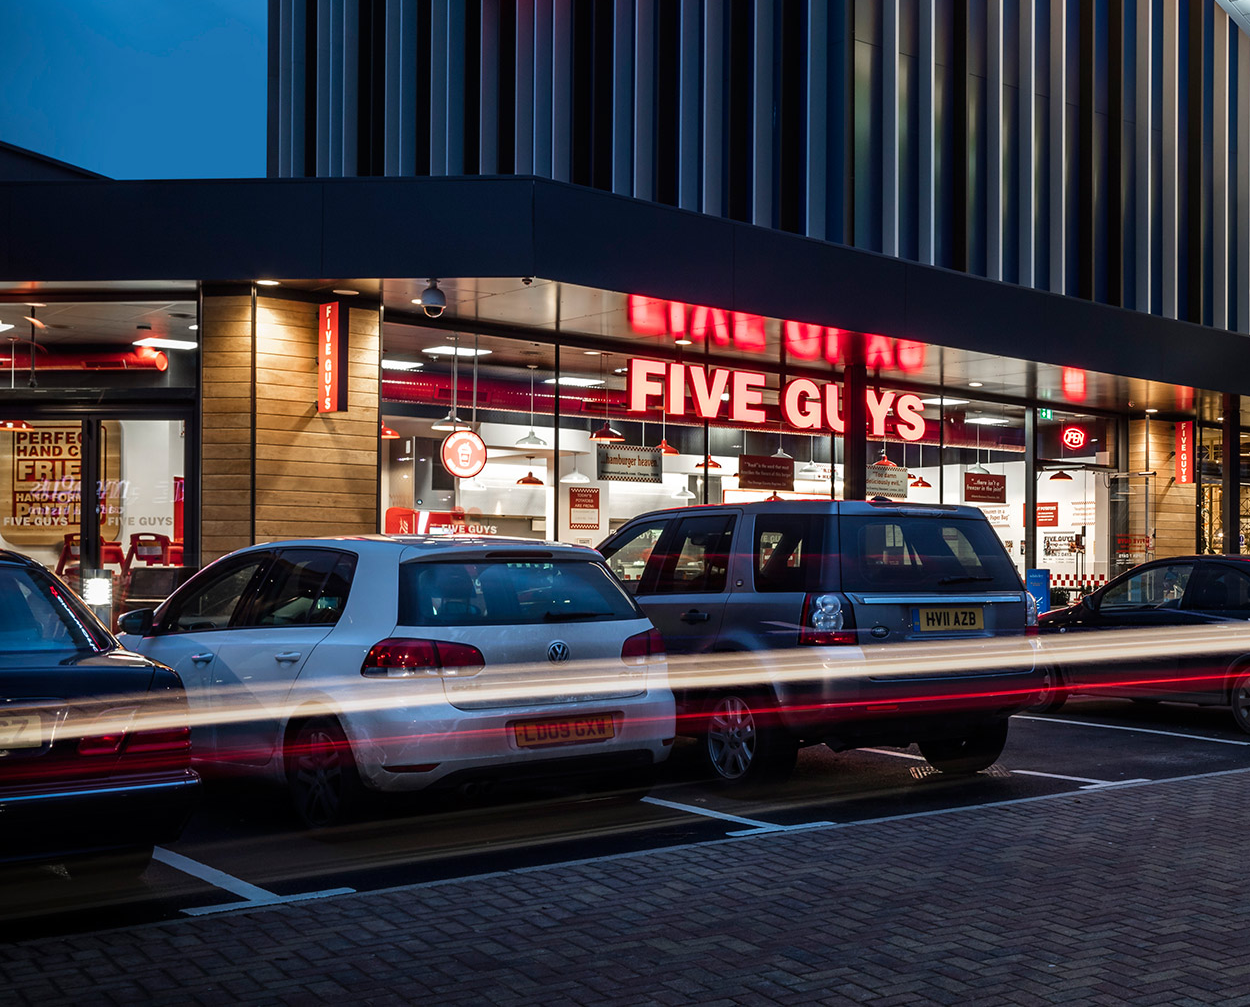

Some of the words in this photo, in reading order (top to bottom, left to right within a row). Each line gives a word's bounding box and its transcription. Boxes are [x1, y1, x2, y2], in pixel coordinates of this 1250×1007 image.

[324, 358, 332, 410] GUYS
[626, 357, 766, 423] FIVE
[780, 378, 926, 442] GUYS
[16, 445, 63, 457] HAND
[3, 517, 31, 526] FIVE
[34, 517, 69, 526] GUYS
[108, 517, 136, 526] FIVE
[139, 517, 173, 526] GUYS
[468, 524, 498, 534] GUYS
[953, 610, 976, 626] AZB
